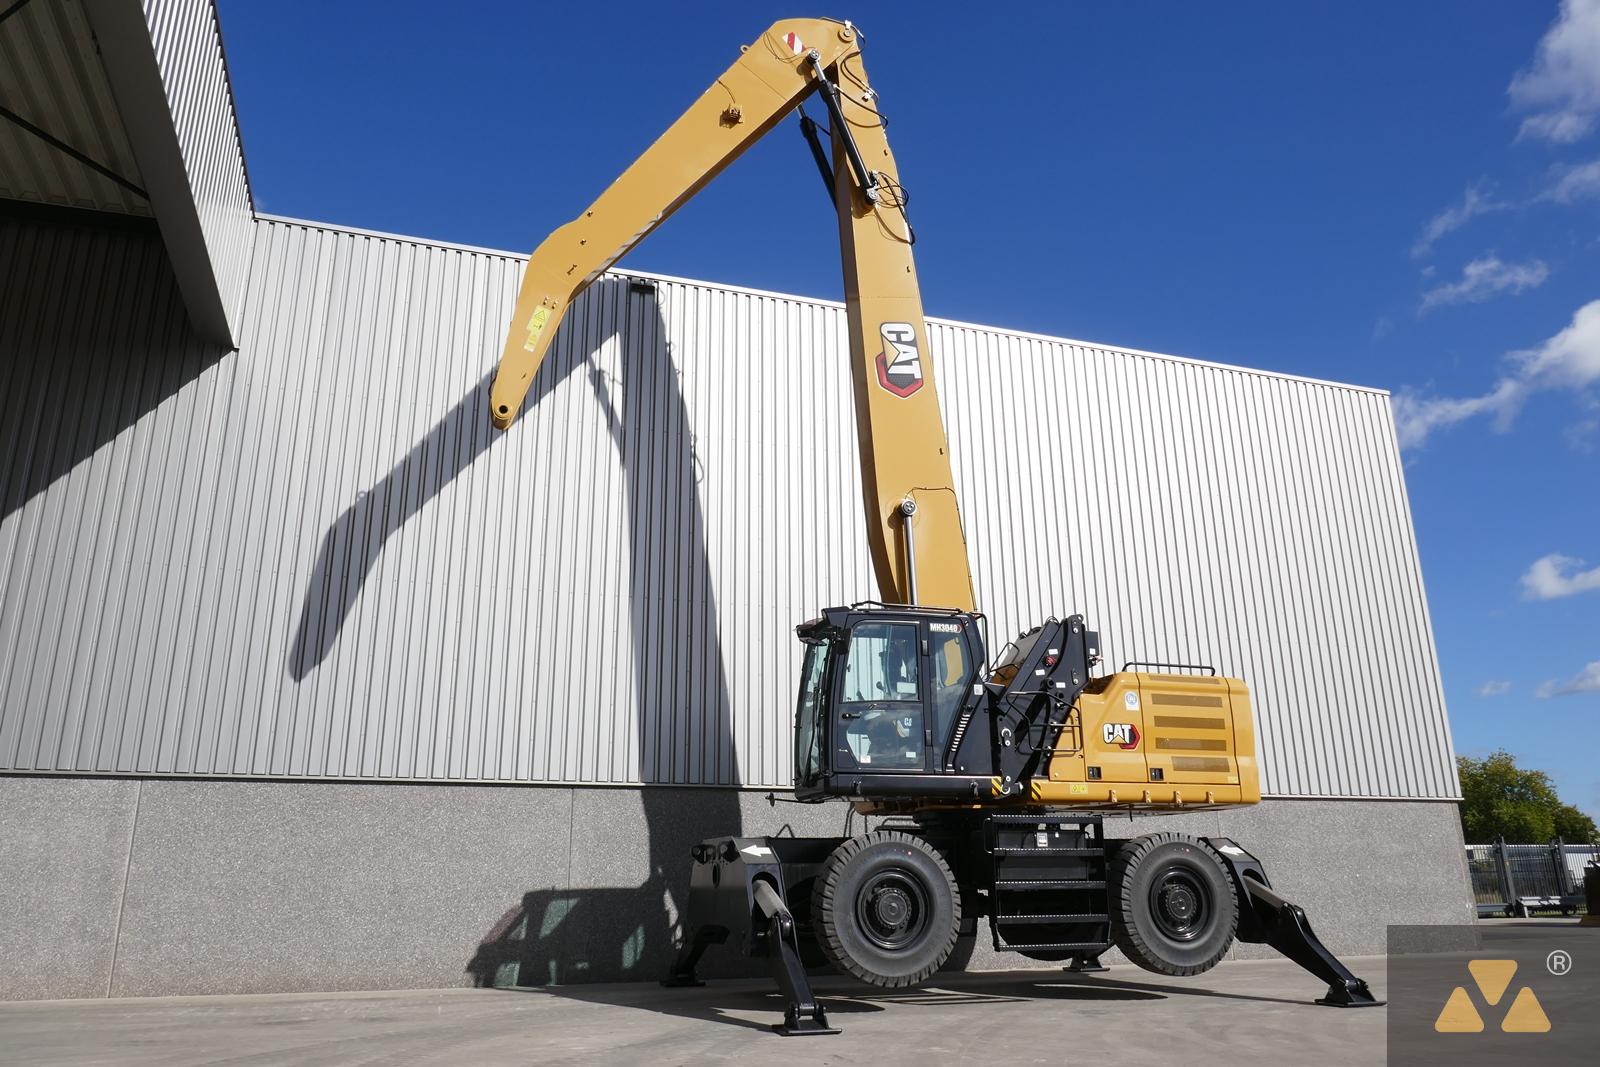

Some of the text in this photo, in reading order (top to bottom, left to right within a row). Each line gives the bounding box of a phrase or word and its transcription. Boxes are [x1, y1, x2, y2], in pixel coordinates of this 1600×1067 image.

[880, 322, 922, 380] CAT
[929, 622, 959, 633] MH3040
[1103, 724, 1132, 745] CAT
